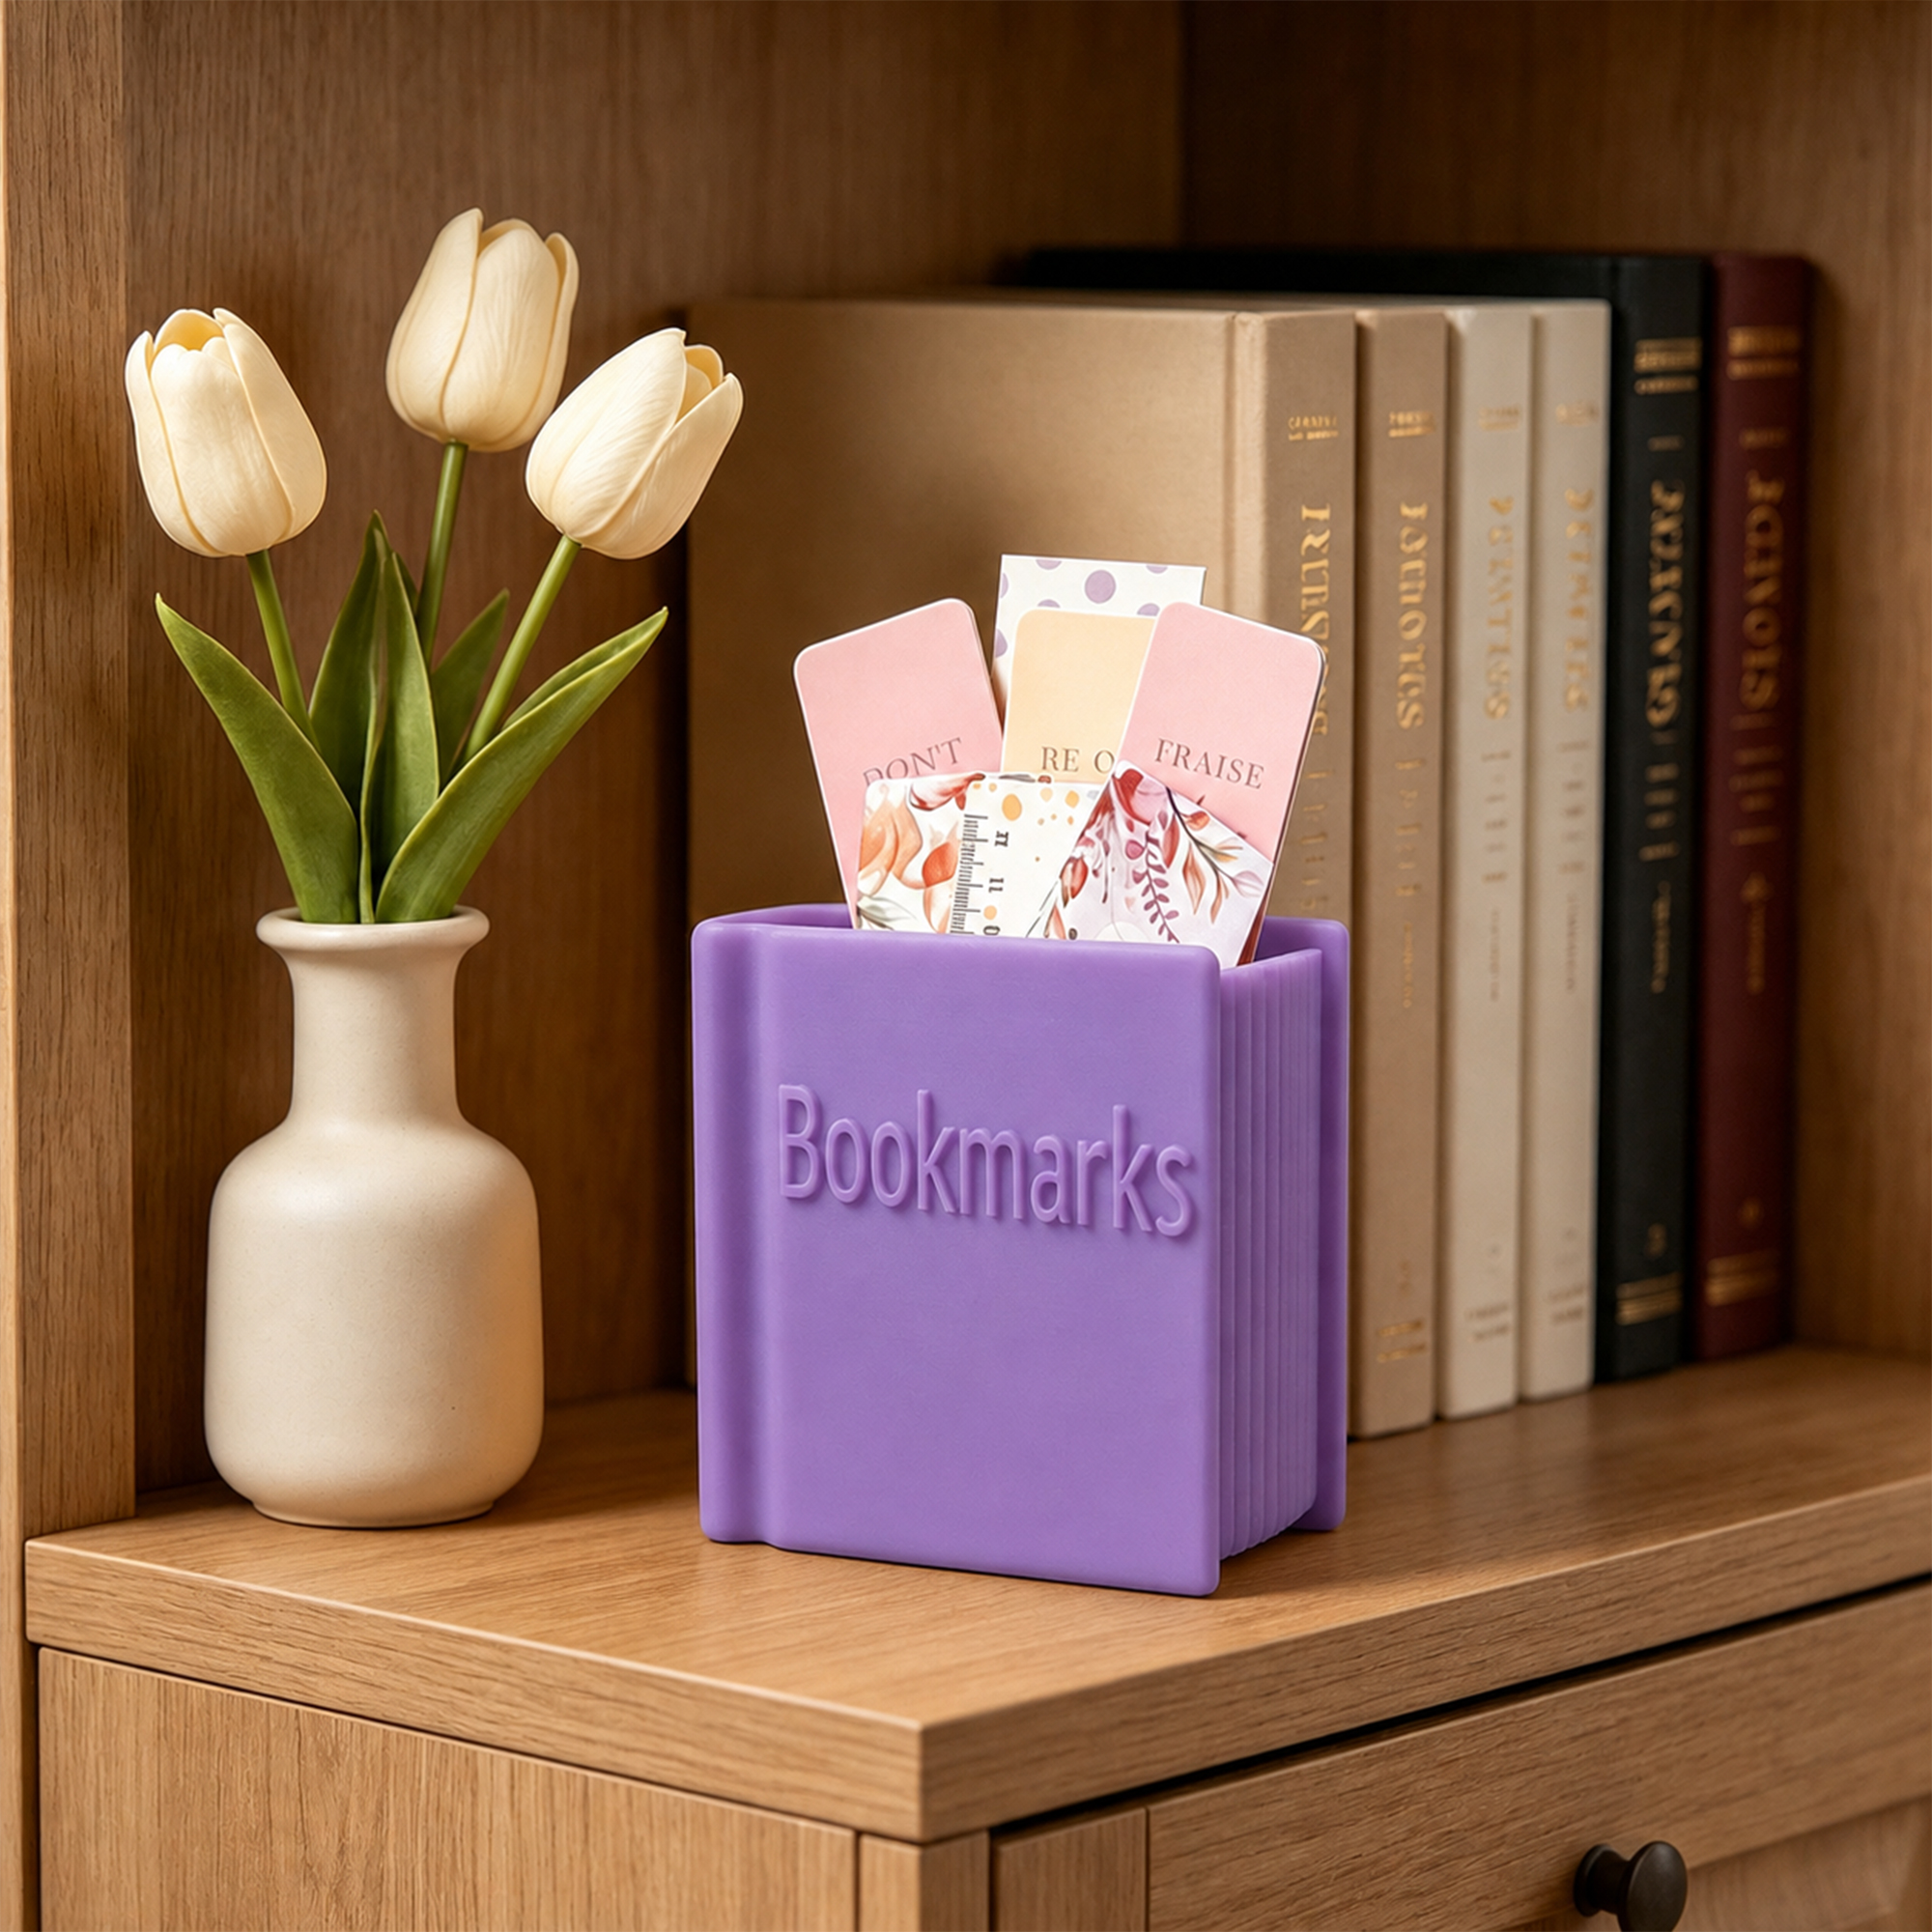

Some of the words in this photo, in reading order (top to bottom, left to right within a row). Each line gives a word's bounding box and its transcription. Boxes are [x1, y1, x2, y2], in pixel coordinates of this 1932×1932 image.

[1041, 746, 1080, 772] RE
[1154, 737, 1264, 789] FRAISE
[778, 1083, 1196, 1238] Bookmarks
